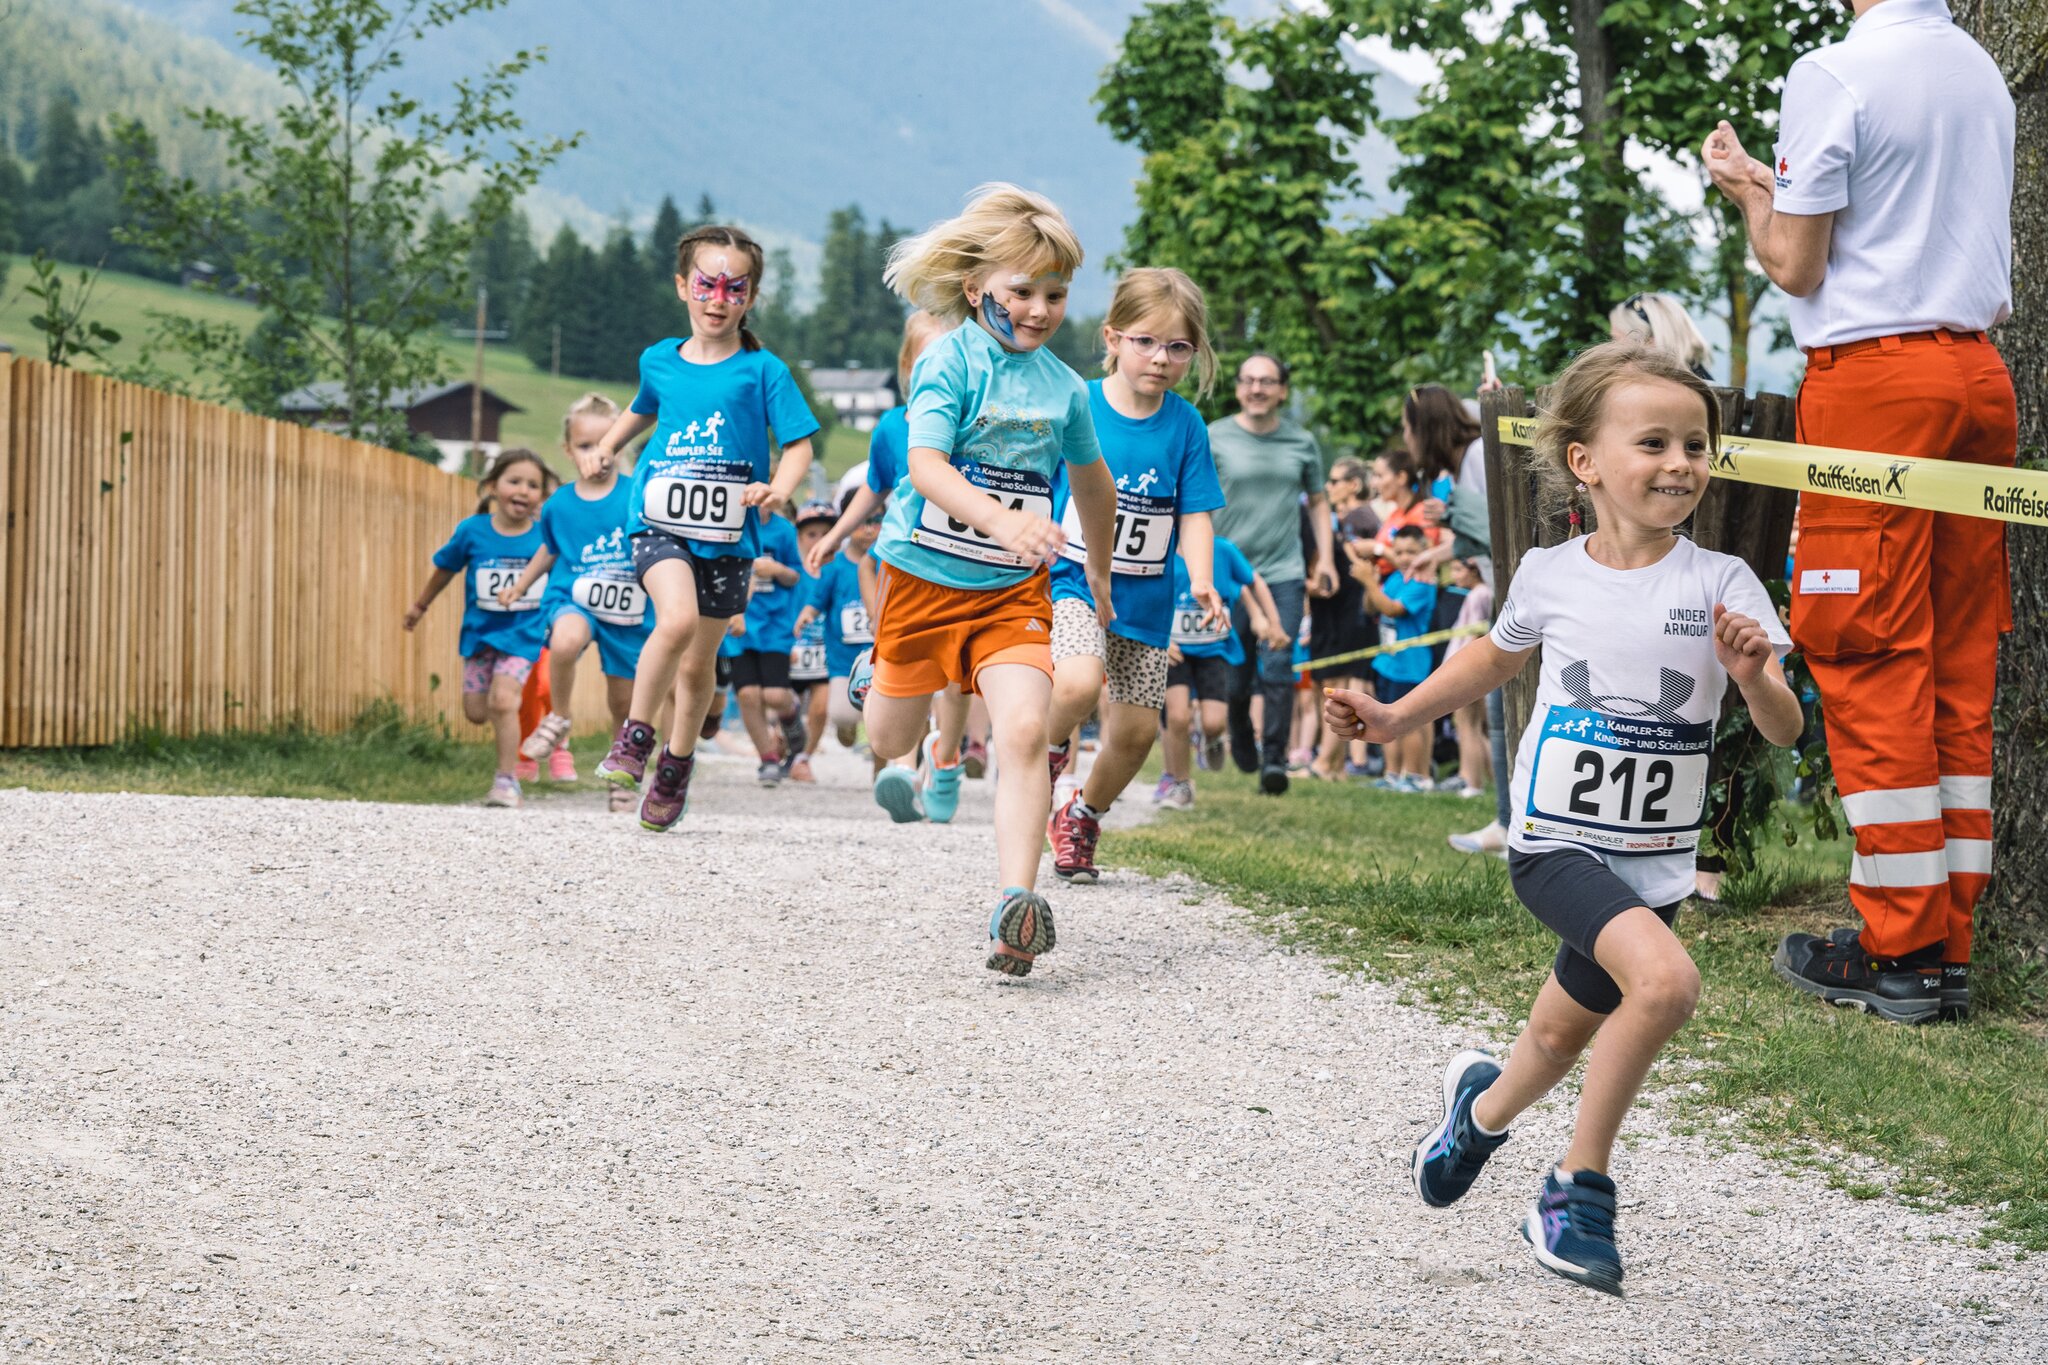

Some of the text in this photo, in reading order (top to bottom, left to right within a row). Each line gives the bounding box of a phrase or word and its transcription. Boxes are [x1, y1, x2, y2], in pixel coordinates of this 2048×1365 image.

[981, 466, 1025, 481] KAMPLER-SEE
[1808, 463, 1881, 495] Raiffeisen
[667, 482, 728, 523] 009
[1113, 513, 1151, 557] 15
[588, 582, 634, 611] 006
[1669, 608, 1706, 623] UNDER
[1663, 622, 1709, 637] ARMOUR
[1607, 721, 1674, 738] KAMPLER-SEE
[1593, 731, 1709, 751] KINDER- UND SCHÜLERLAUF
[1569, 749, 1674, 822] 212
[1583, 831, 1625, 844] BRANDAUER
